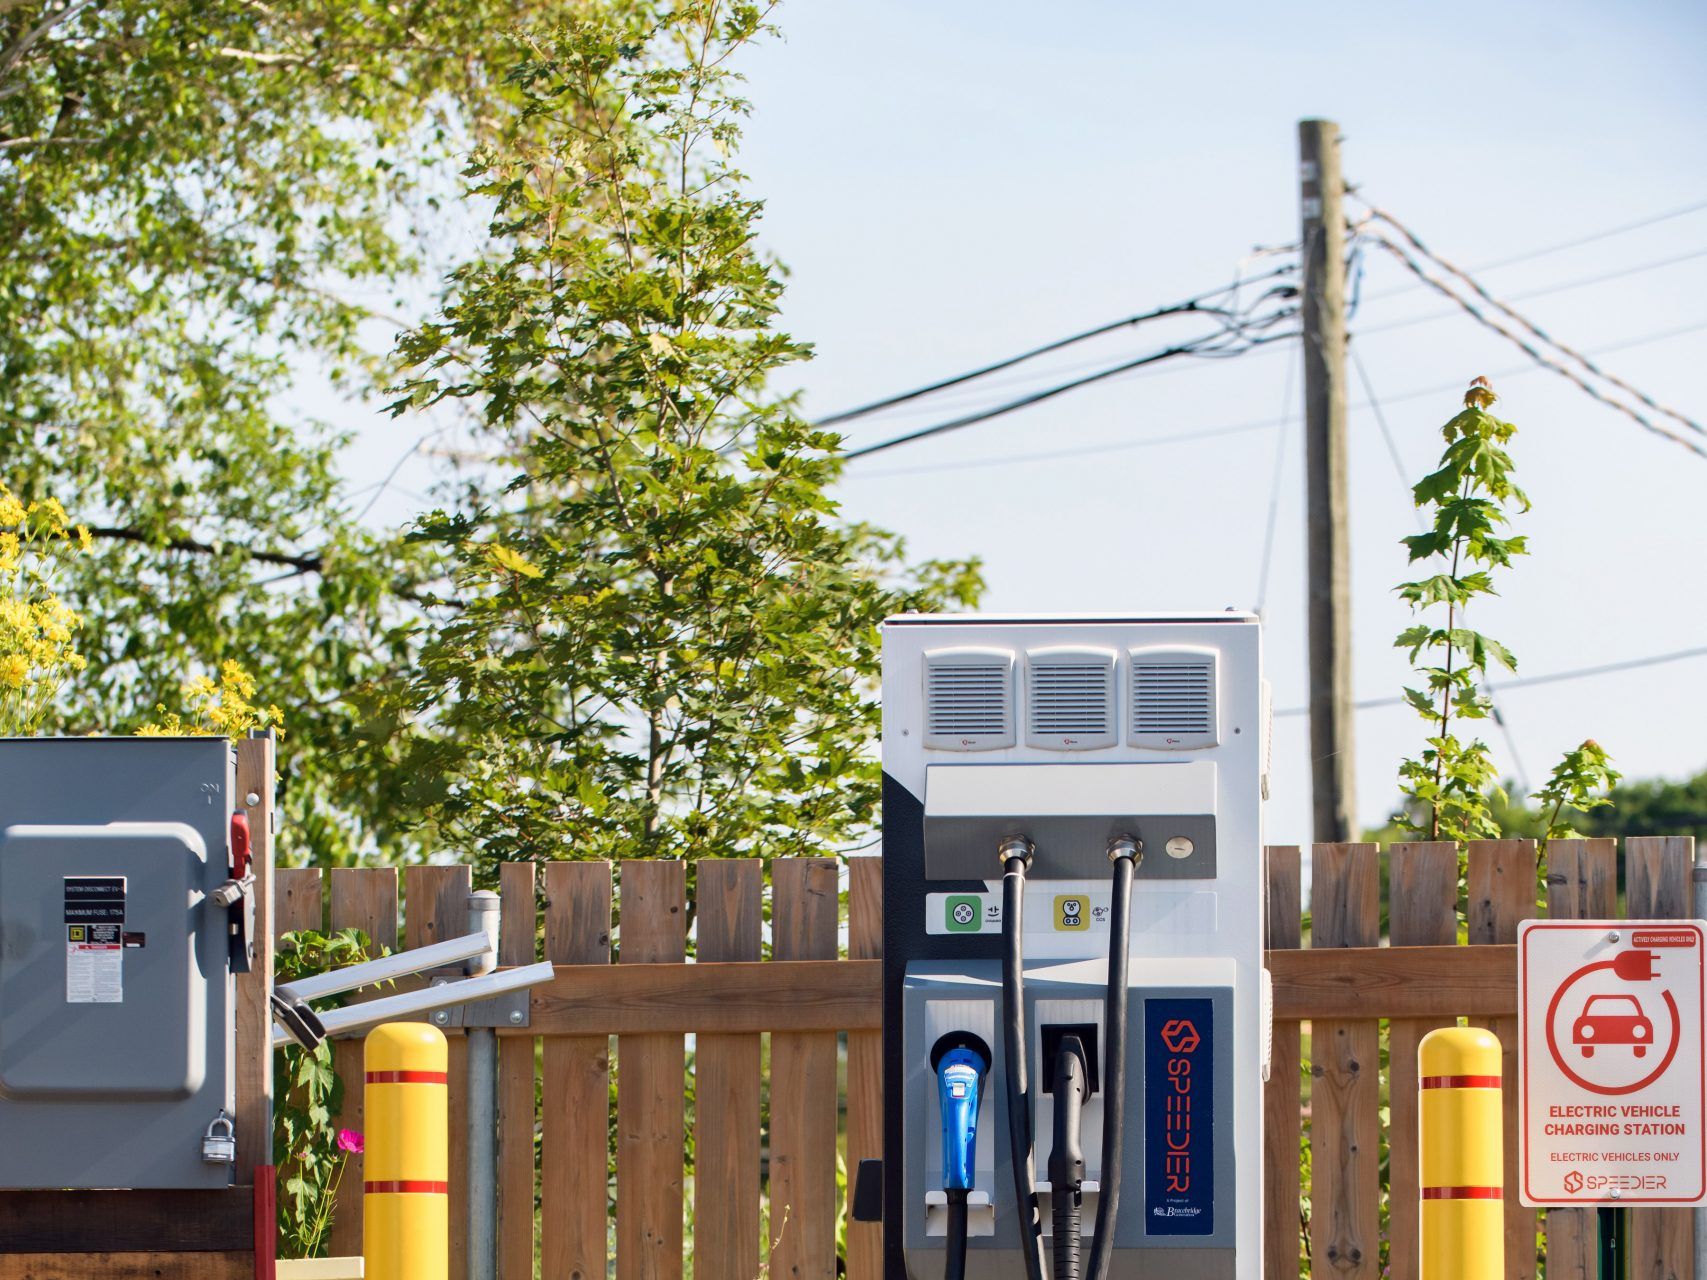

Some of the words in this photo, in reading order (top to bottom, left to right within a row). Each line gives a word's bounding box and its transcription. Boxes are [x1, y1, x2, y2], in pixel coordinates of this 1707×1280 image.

[1549, 1105, 1617, 1118] ELECTRIC
[1620, 1105, 1680, 1118] VEHICLE
[1166, 1058, 1191, 1193] SPEEDIER
[1544, 1123, 1620, 1136] CHARGING
[1623, 1123, 1685, 1136] STATION
[1550, 1152, 1599, 1162] ELECTRIC
[1601, 1152, 1651, 1162] VEHICLES
[1653, 1152, 1680, 1162] ONLY
[1586, 1175, 1667, 1190] SPEEDIER
